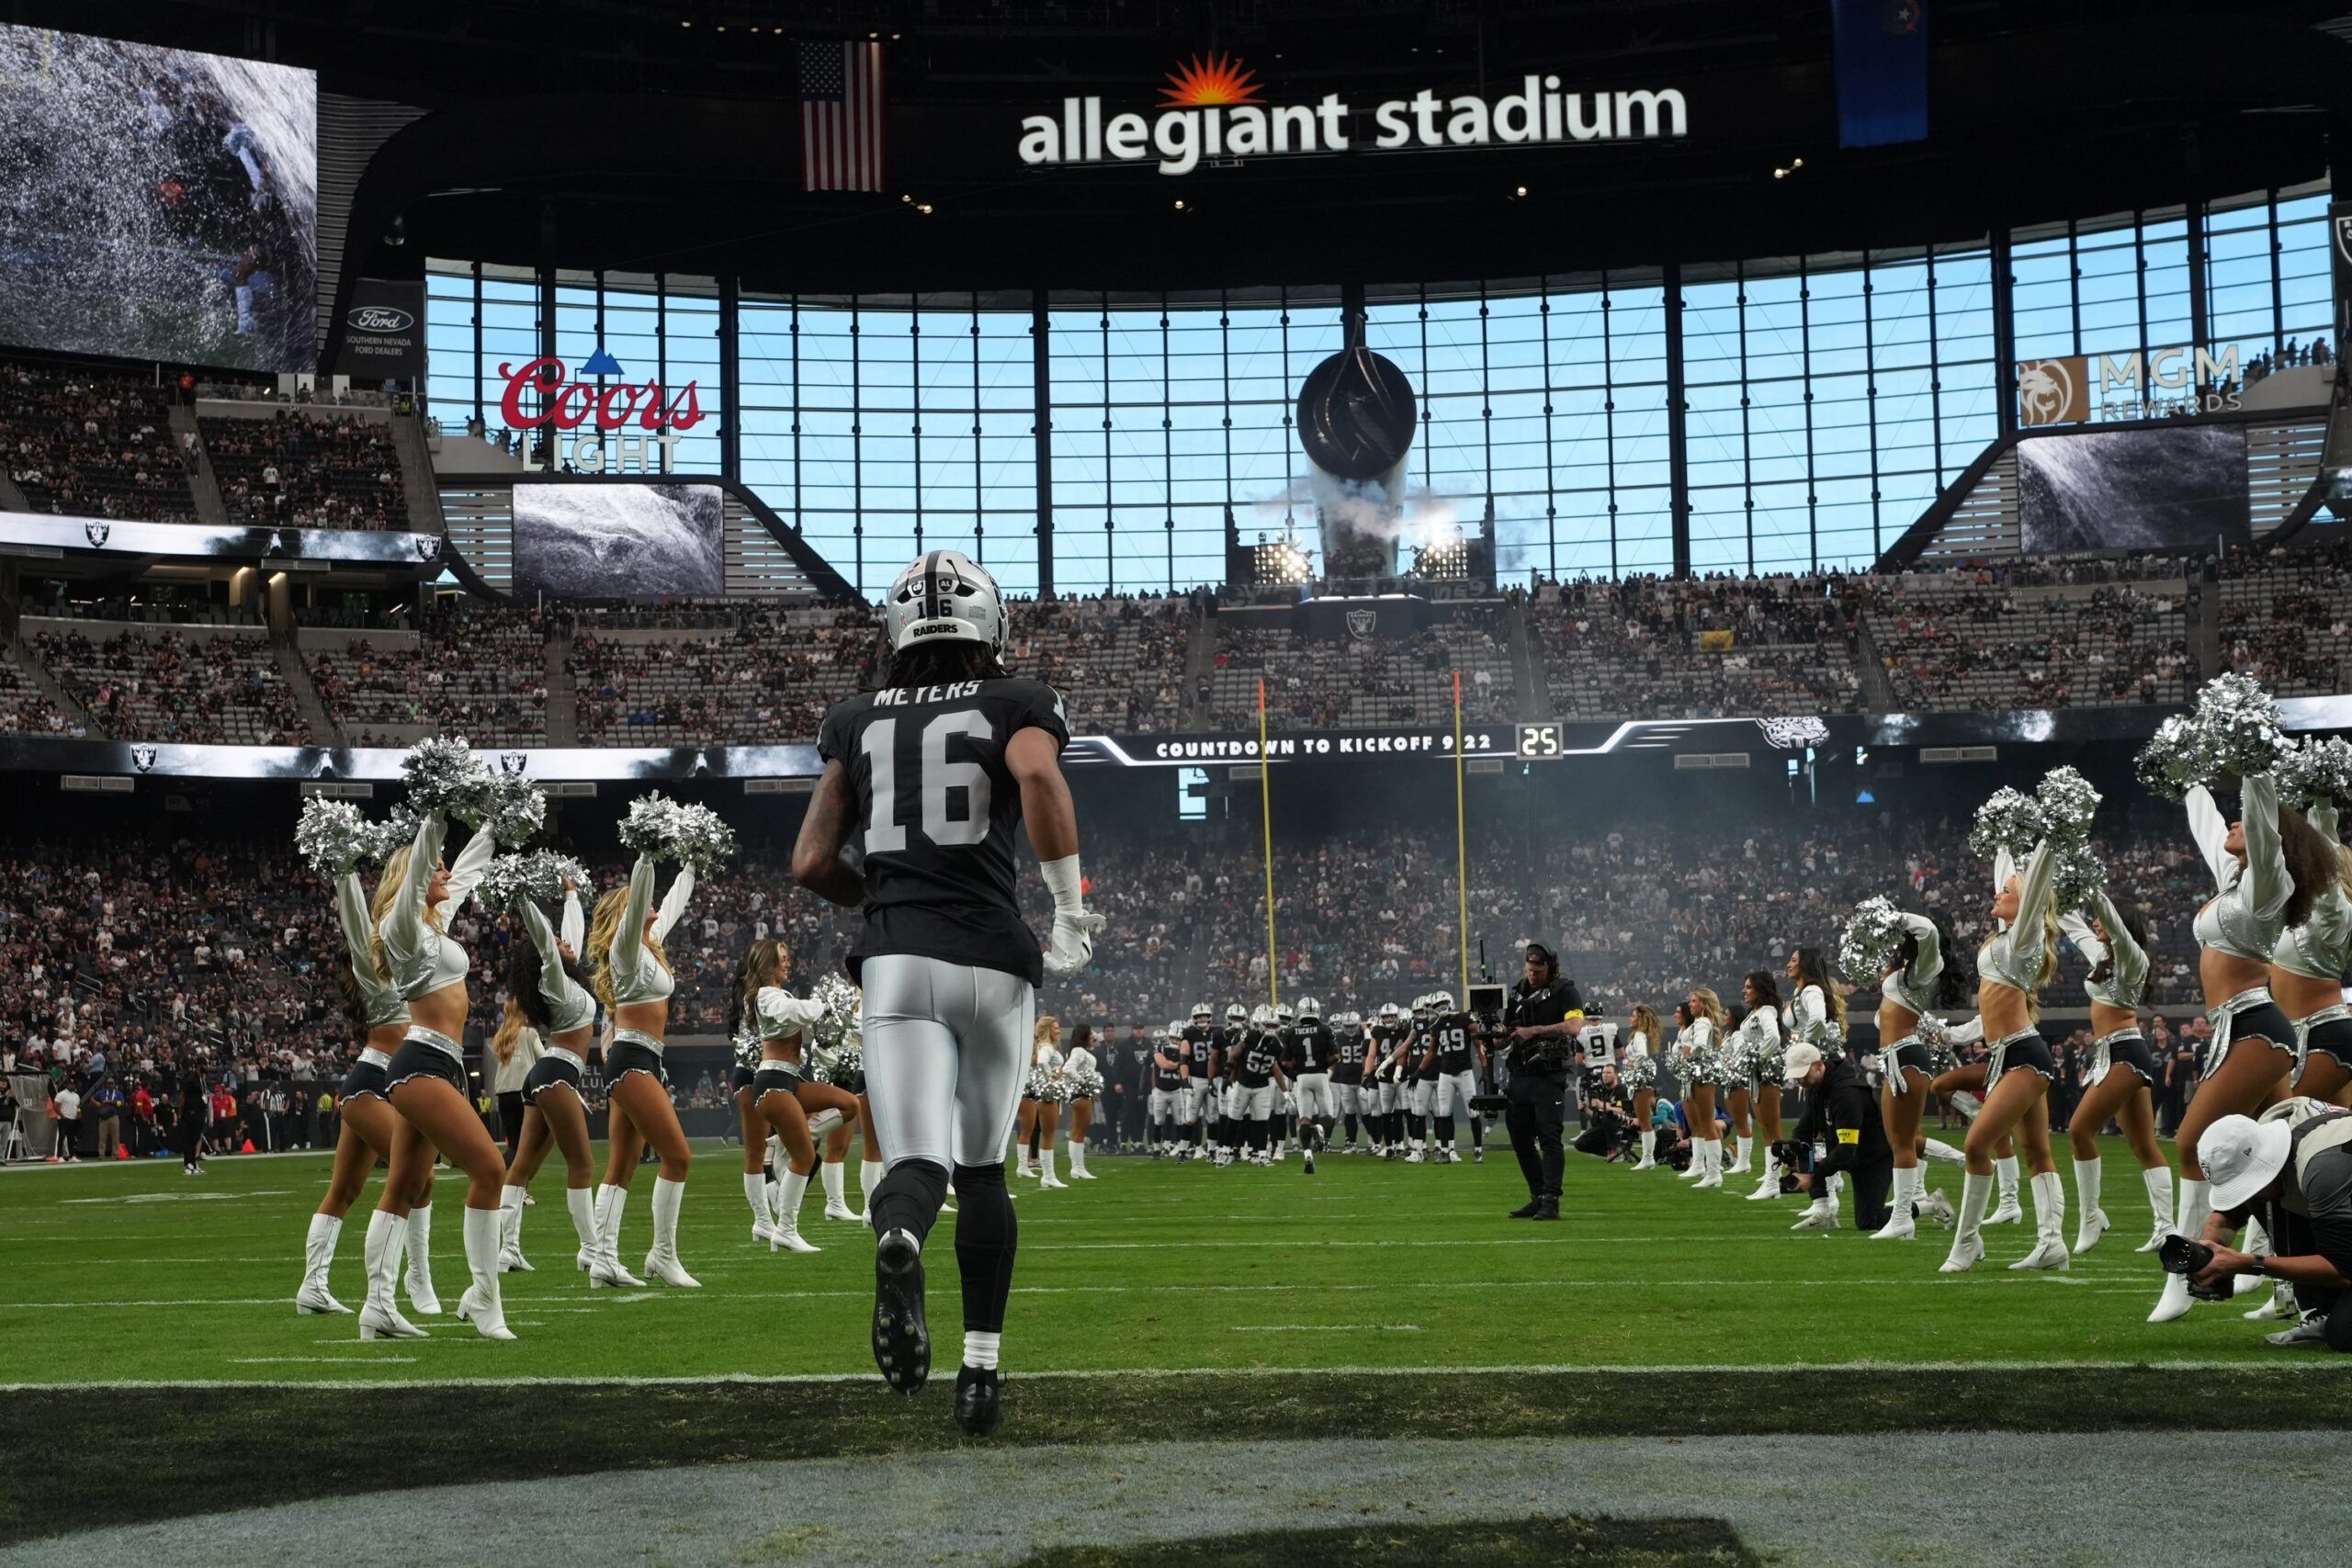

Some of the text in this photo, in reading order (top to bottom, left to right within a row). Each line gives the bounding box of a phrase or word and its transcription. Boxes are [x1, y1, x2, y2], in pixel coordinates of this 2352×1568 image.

[1018, 74, 1688, 175] allegiant stadium
[358, 310, 401, 328] Ford
[346, 336, 412, 346] SOUTHERN NEVADA
[356, 346, 402, 355] FORD DEALERS
[2098, 344, 2241, 394] MGM
[499, 357, 706, 430] Coors
[2101, 392, 2243, 422] REWARDS
[522, 434, 683, 473] LIGHT
[913, 625, 958, 637] RAIDERS
[1157, 739, 1295, 758] COUNTDOWN
[1304, 739, 1330, 753] TO
[1340, 736, 1432, 753] KICKOFF
[1522, 728, 1557, 756] 25
[861, 709, 993, 855] 16
[1295, 1026, 1317, 1035] TUCKER
[1438, 1029, 1465, 1053] 49
[1302, 1037, 1316, 1066] 1
[1341, 1045, 1363, 1064] 95
[1590, 1034, 1606, 1057] 9
[1246, 1051, 1276, 1075] 52
